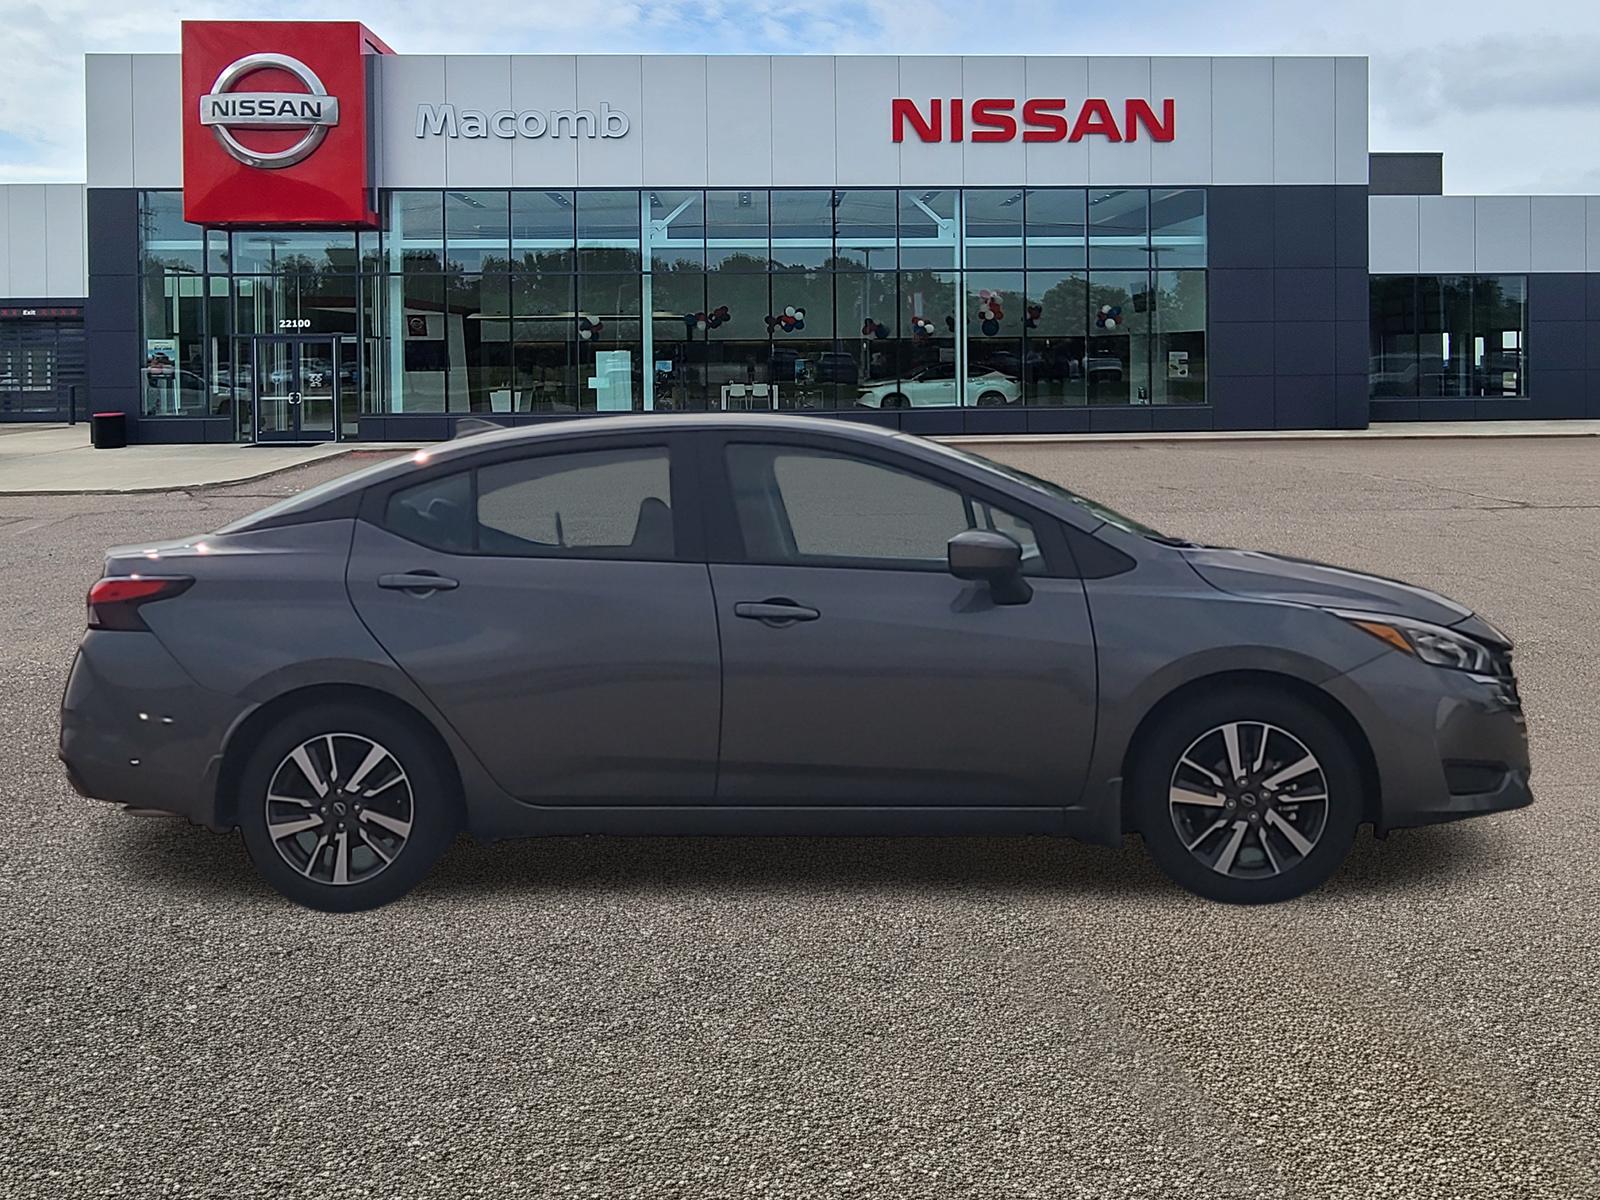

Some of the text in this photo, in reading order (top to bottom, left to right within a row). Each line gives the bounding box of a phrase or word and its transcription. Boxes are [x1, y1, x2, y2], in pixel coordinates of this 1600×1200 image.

[211, 100, 322, 117] NISSAN
[415, 102, 630, 139] Macomb
[891, 98, 1175, 143] NISSAN
[279, 319, 311, 328] 22100
